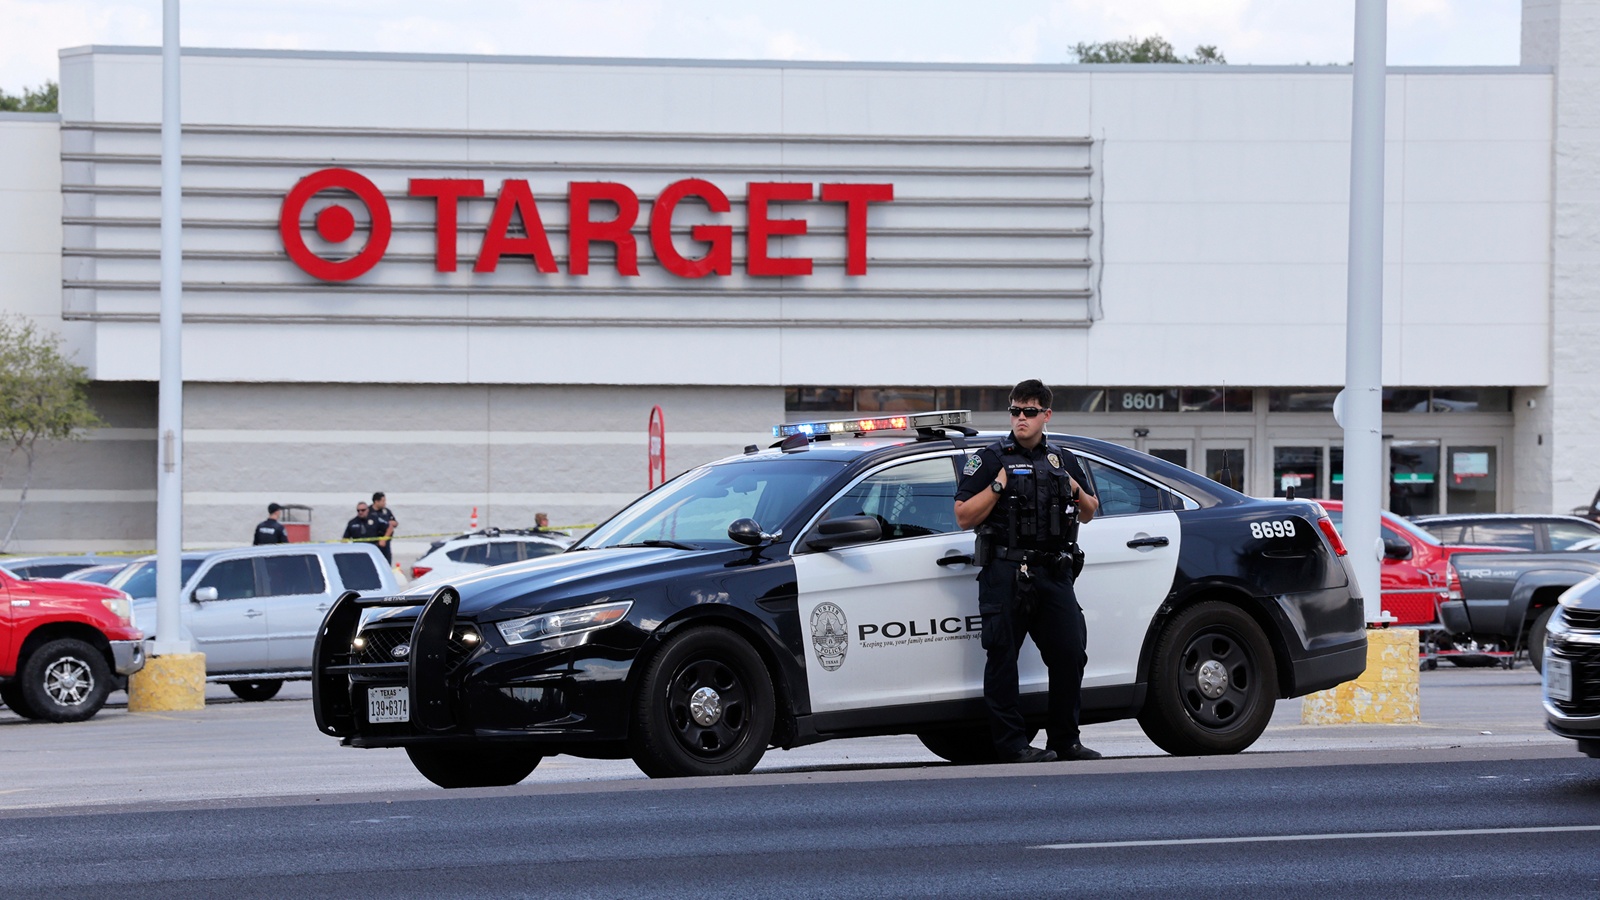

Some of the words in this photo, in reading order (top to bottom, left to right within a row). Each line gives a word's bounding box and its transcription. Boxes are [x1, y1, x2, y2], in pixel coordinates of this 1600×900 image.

[408, 178, 894, 277] TARGET
[1122, 393, 1164, 409] 8601
[1250, 520, 1296, 539] 8699
[815, 605, 839, 617] AUSTIN
[858, 615, 983, 640] POLICE
[907, 637, 923, 645] family
[944, 633, 971, 641] community
[820, 646, 842, 654] POLICE
